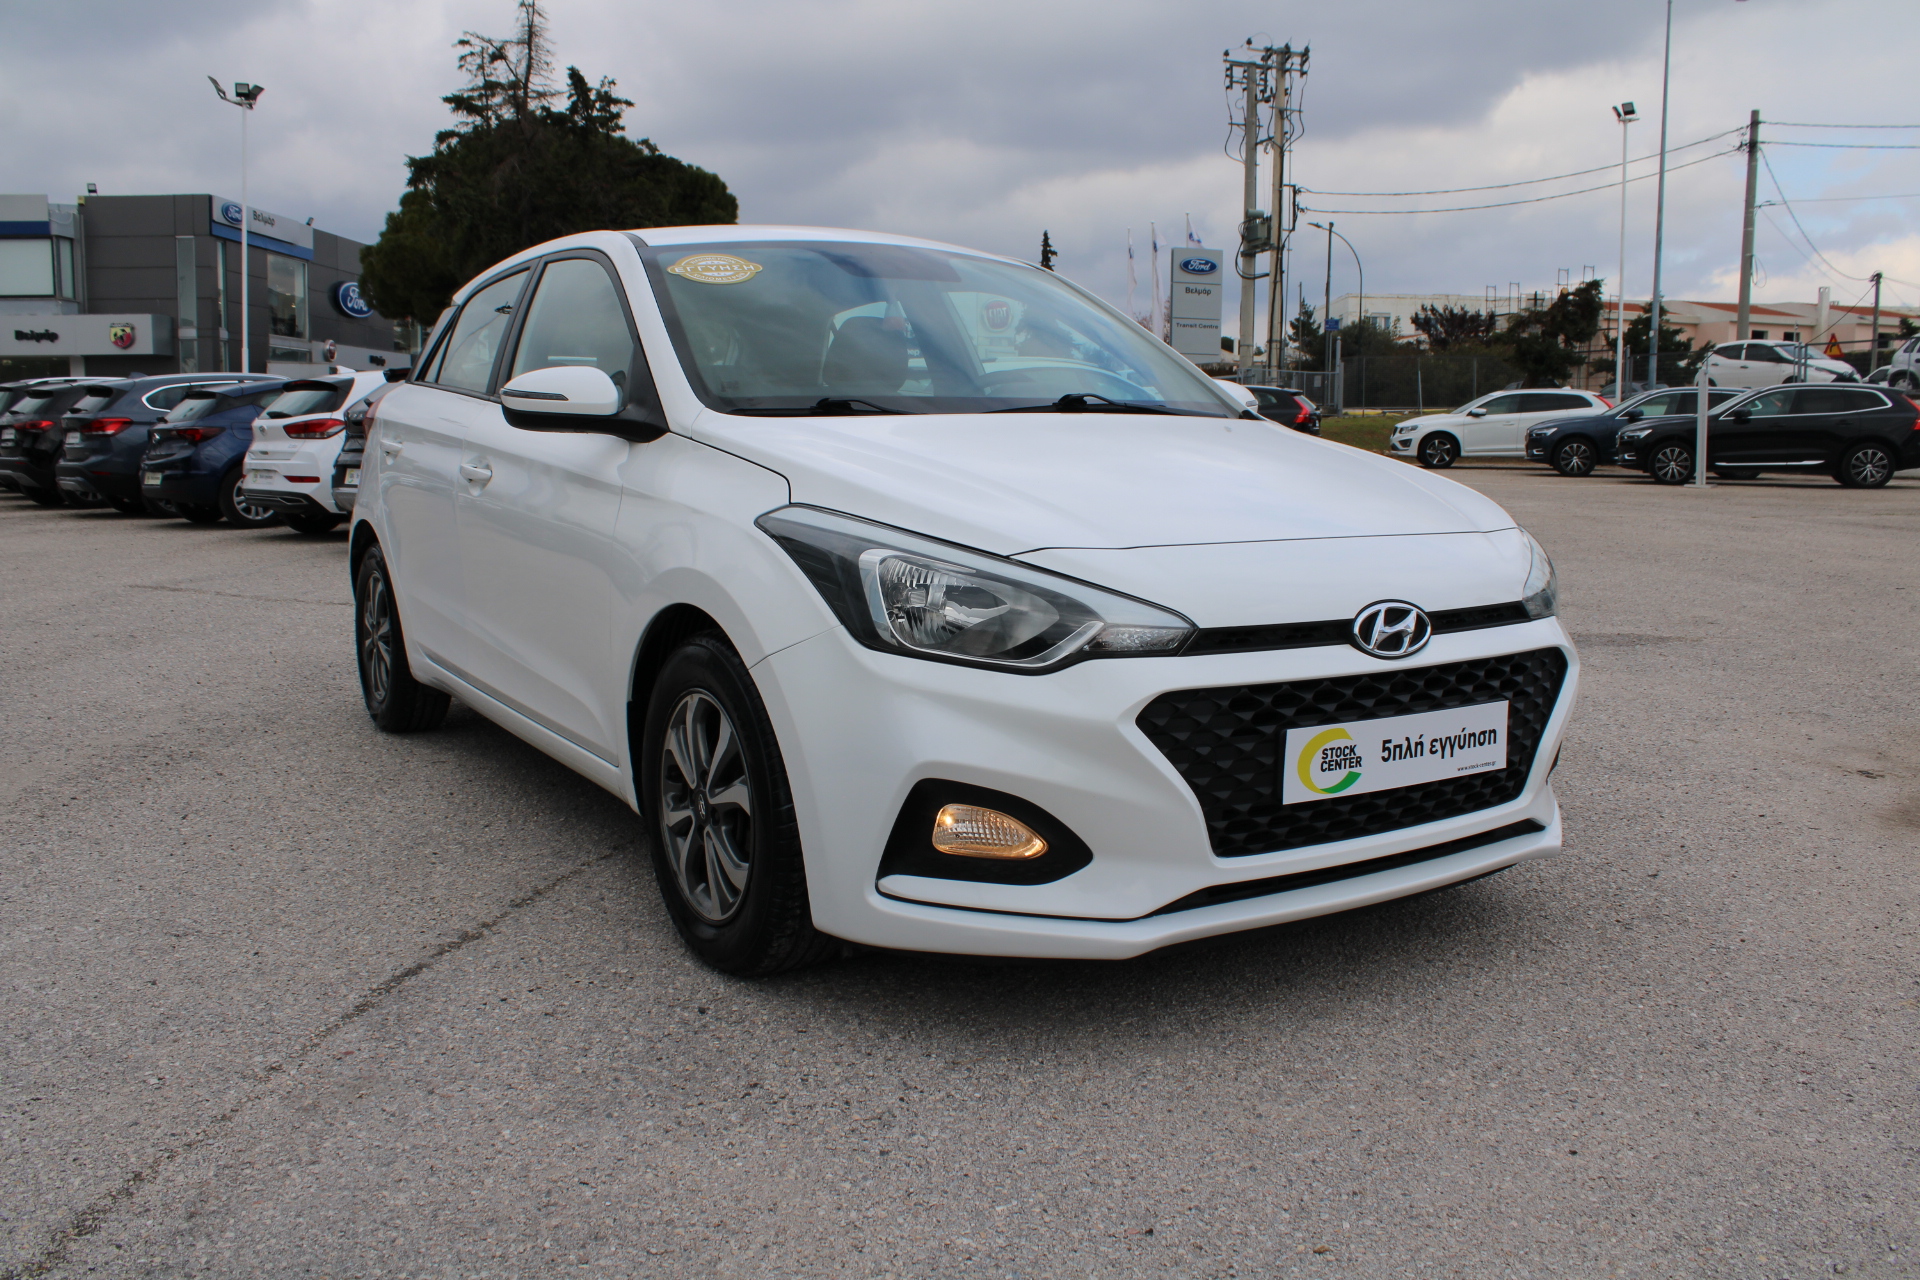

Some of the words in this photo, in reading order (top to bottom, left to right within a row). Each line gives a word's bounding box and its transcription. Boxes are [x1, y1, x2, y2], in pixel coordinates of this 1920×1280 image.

[675, 265, 755, 273] ΕΓΓΥΗΣΗ
[1188, 259, 1211, 271] Ford
[1185, 286, 1212, 296] Βελμάρ
[1321, 744, 1357, 760] STOCK
[1381, 733, 1424, 763] 5πλή
[1429, 727, 1497, 759] εγγύηση
[1320, 756, 1363, 773] CENTER
